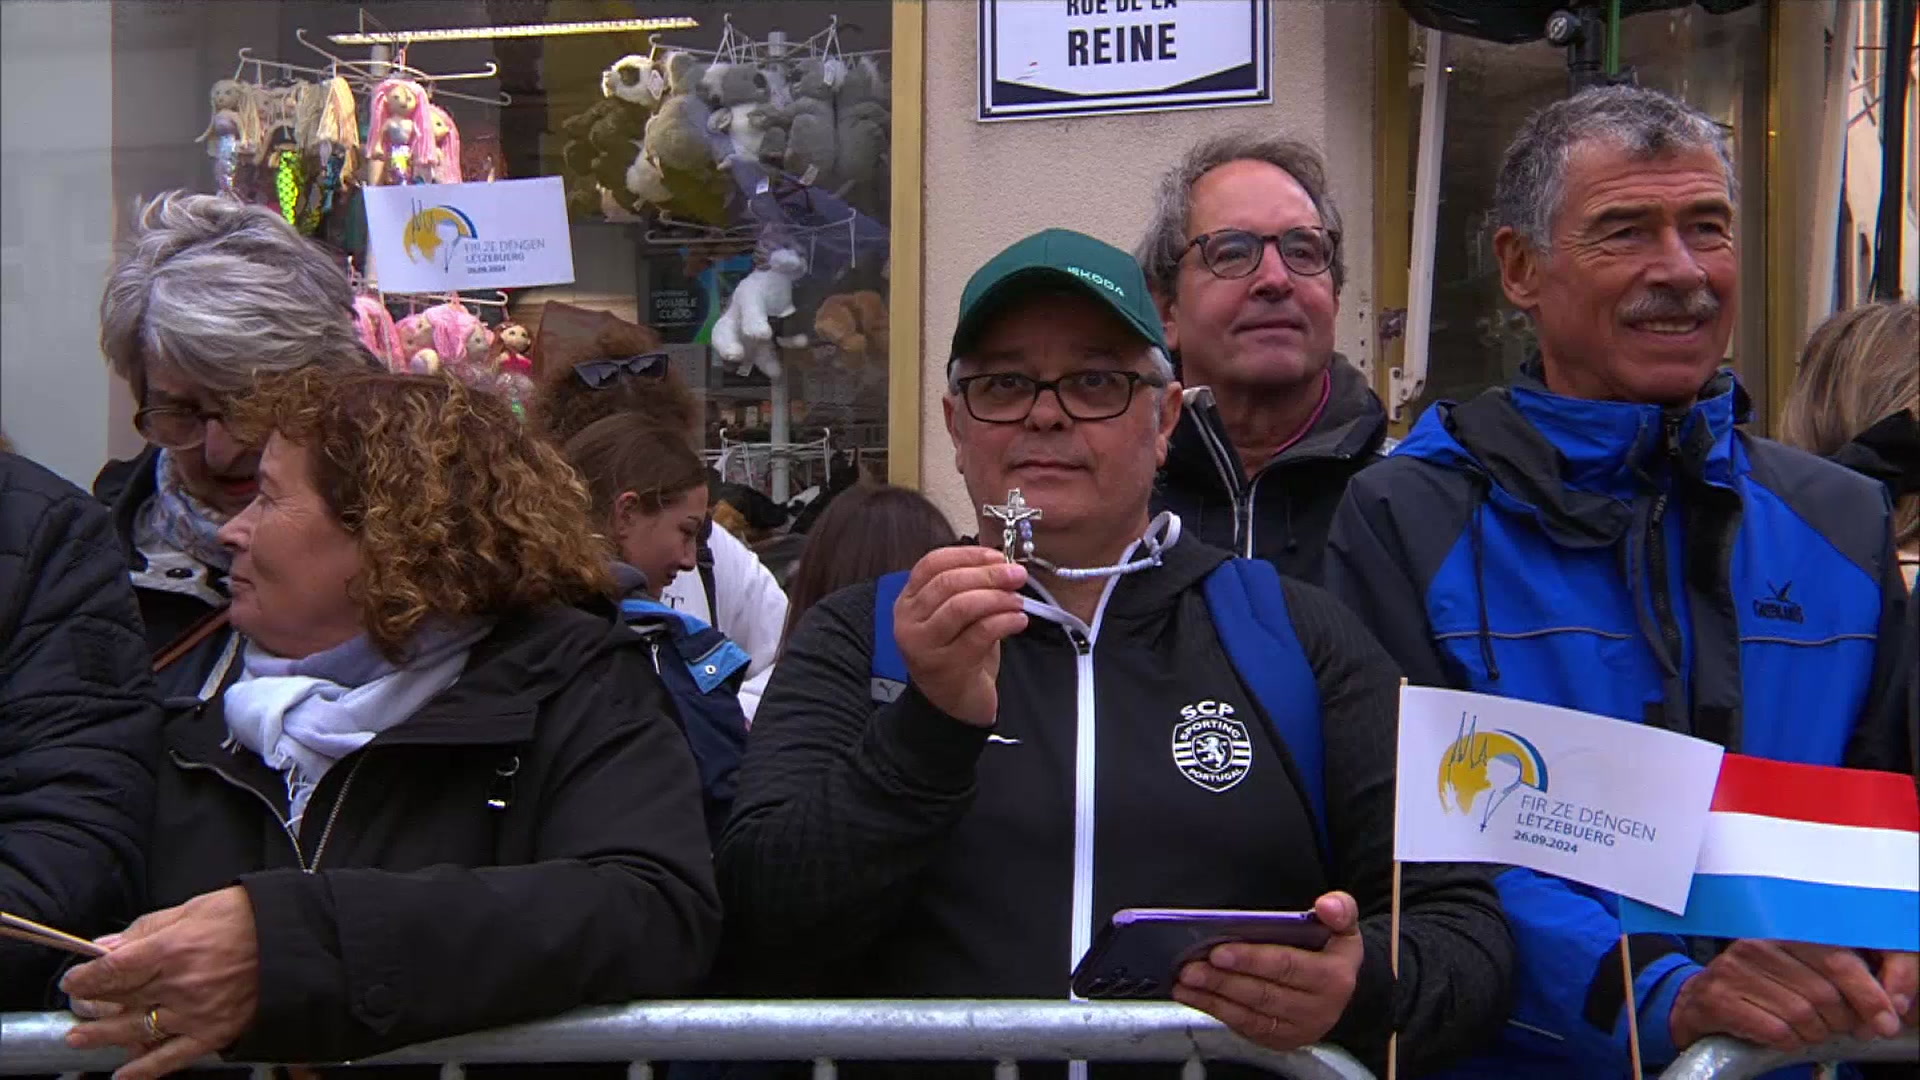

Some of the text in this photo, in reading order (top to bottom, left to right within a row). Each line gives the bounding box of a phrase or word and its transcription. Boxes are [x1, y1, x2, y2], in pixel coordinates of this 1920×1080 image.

[1067, 0, 1107, 16] RUE
[1068, 22, 1177, 66] REINE
[1180, 700, 1235, 721] SCP
[1180, 720, 1241, 740] SPORTING
[1188, 767, 1244, 782] PORTUGAL
[1521, 794, 1548, 813] FIR
[1551, 801, 1575, 819] ZE
[1514, 829, 1578, 854] 26.09.2024
